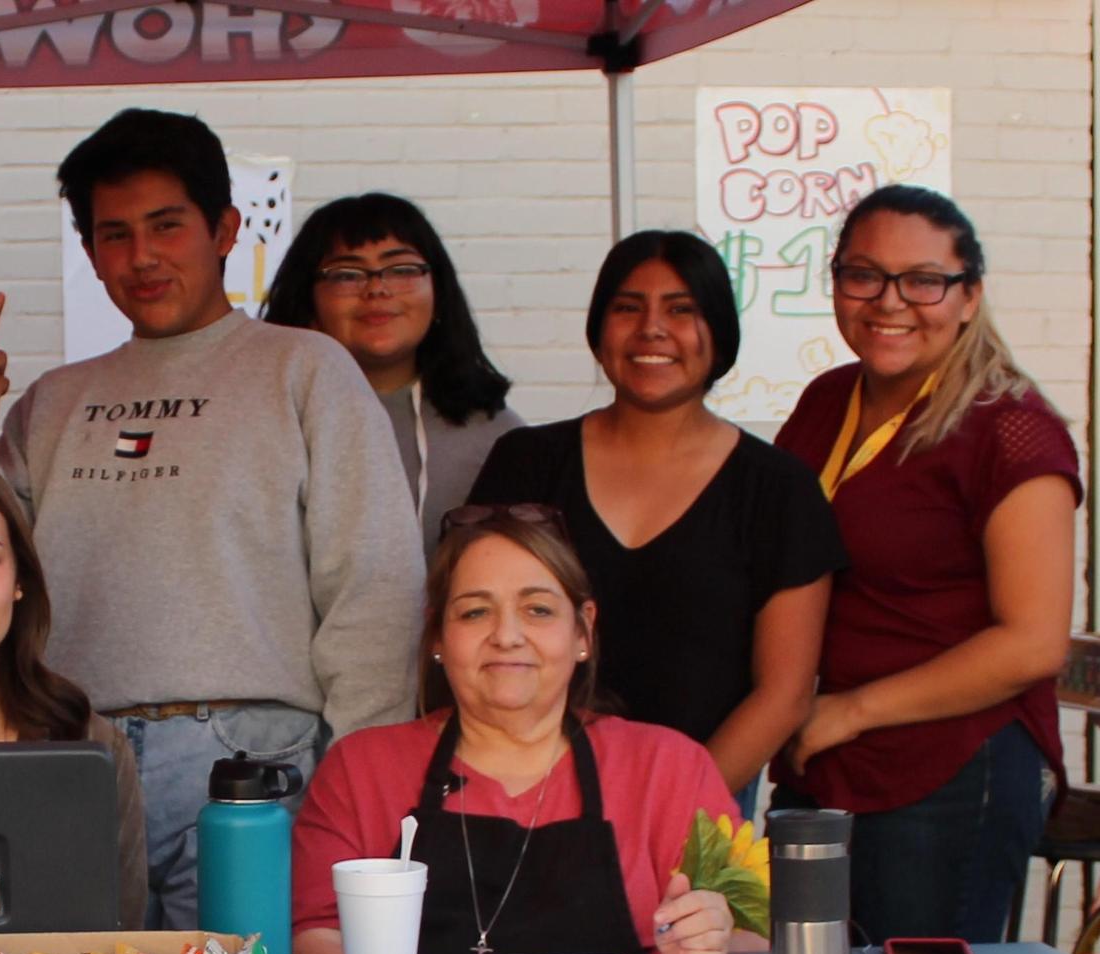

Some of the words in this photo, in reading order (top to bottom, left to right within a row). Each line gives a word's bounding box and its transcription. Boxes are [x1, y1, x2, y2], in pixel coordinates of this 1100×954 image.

[714, 101, 838, 164] POP
[720, 162, 878, 222] CORN
[85, 399, 209, 422] TOMMY
[72, 465, 180, 483] HILFIGER
